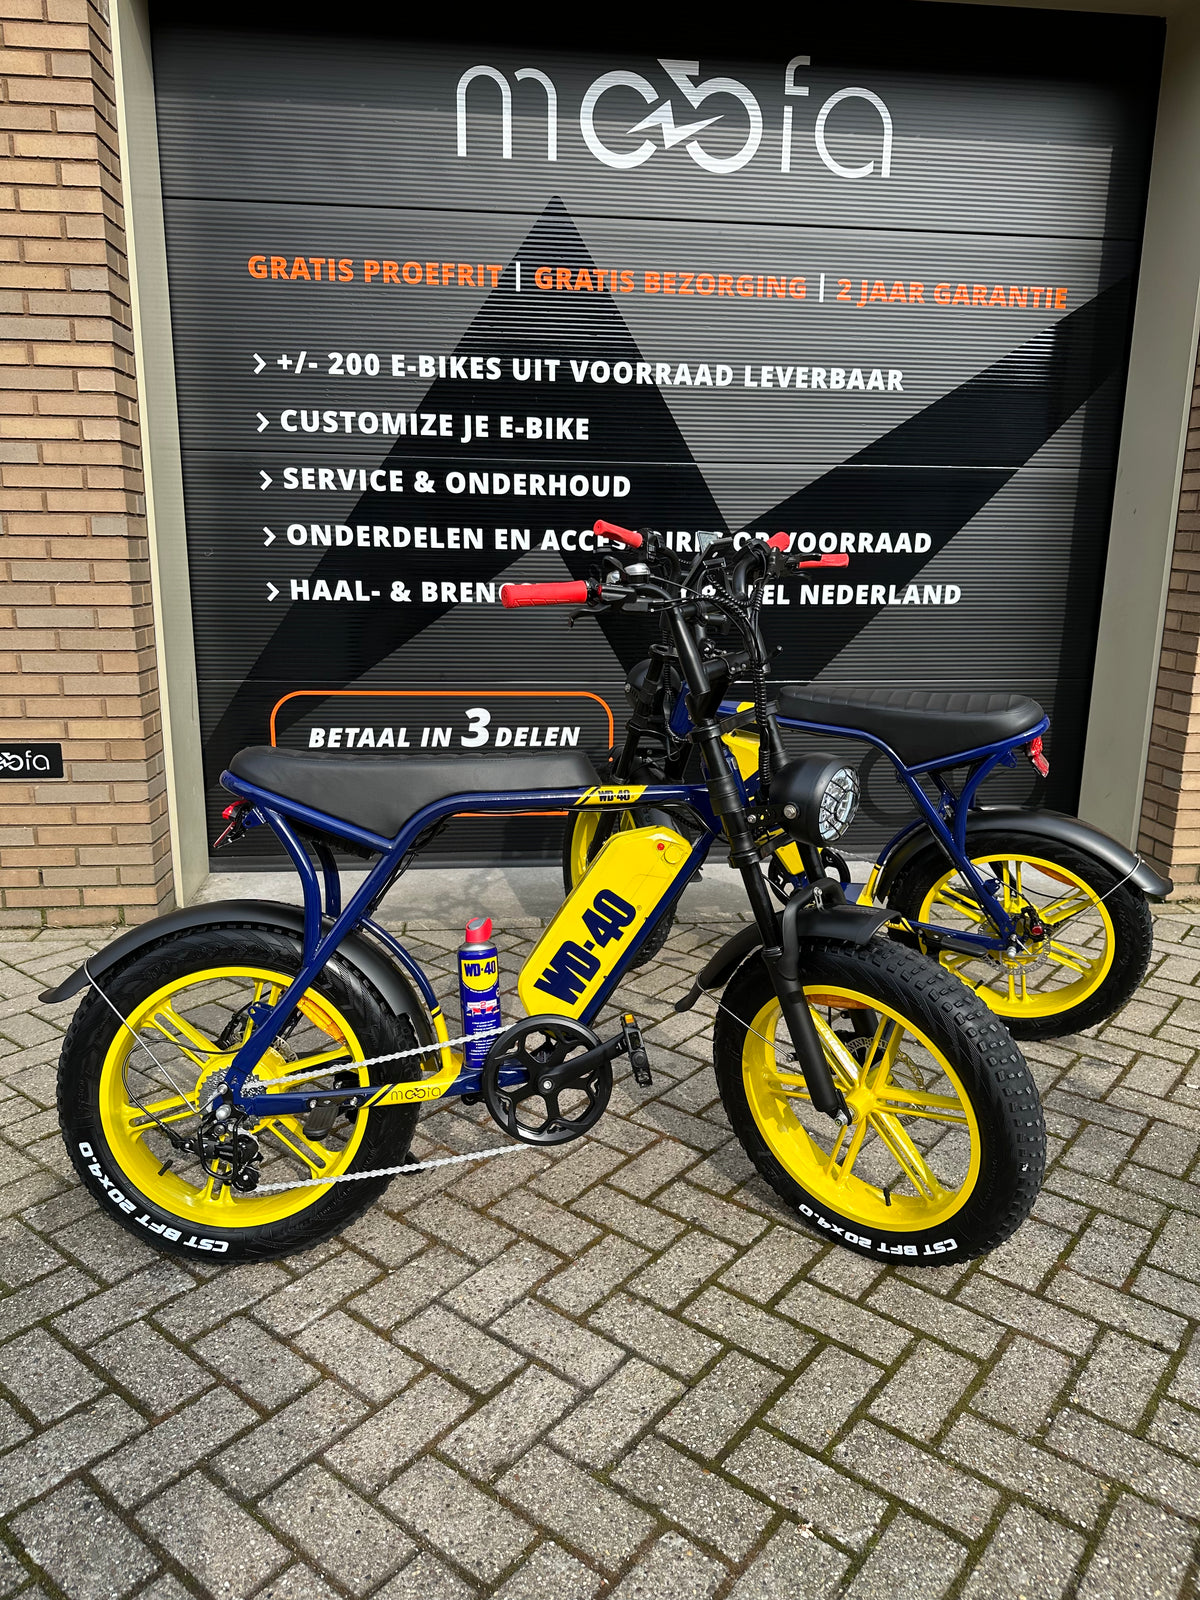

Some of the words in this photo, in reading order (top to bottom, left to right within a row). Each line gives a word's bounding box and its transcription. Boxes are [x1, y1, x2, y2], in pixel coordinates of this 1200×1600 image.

[247, 255, 354, 283] GRATIS
[364, 261, 503, 288] PROEFRIT
[534, 266, 635, 293] GRATIS
[644, 272, 807, 299] BEZORGING
[836, 279, 852, 301] 2
[856, 280, 925, 308] JAAR
[933, 283, 1068, 310] GARANTIE
[328, 352, 381, 376] 200
[391, 354, 502, 380] E-BIKES
[512, 359, 561, 382] UIT
[569, 360, 734, 386] VOORRAAD
[744, 365, 904, 391] LEVERBAAR
[280, 409, 453, 437] CUSTOMIZE
[460, 414, 489, 443] JE
[500, 415, 590, 440] E-BIKE
[283, 467, 404, 492] SERVICE
[413, 470, 436, 493] &
[445, 471, 631, 497] ONDERHOUD
[286, 523, 483, 549] ONDERDELEN
[494, 528, 530, 551] EN
[290, 579, 381, 602] HAAL-
[390, 580, 412, 603] &
[799, 584, 962, 606] NEDERLAND
[308, 727, 411, 749] BETAAL
[420, 727, 453, 748] IN
[460, 707, 492, 748] 3
[494, 726, 581, 748] DELEN
[533, 888, 637, 1006] WD-40
[464, 960, 496, 977] WD-40
[135, 1213, 183, 1242] BFT
[183, 1235, 230, 1253] CST
[876, 1242, 919, 1256] BFT
[922, 1238, 959, 1256] CST
